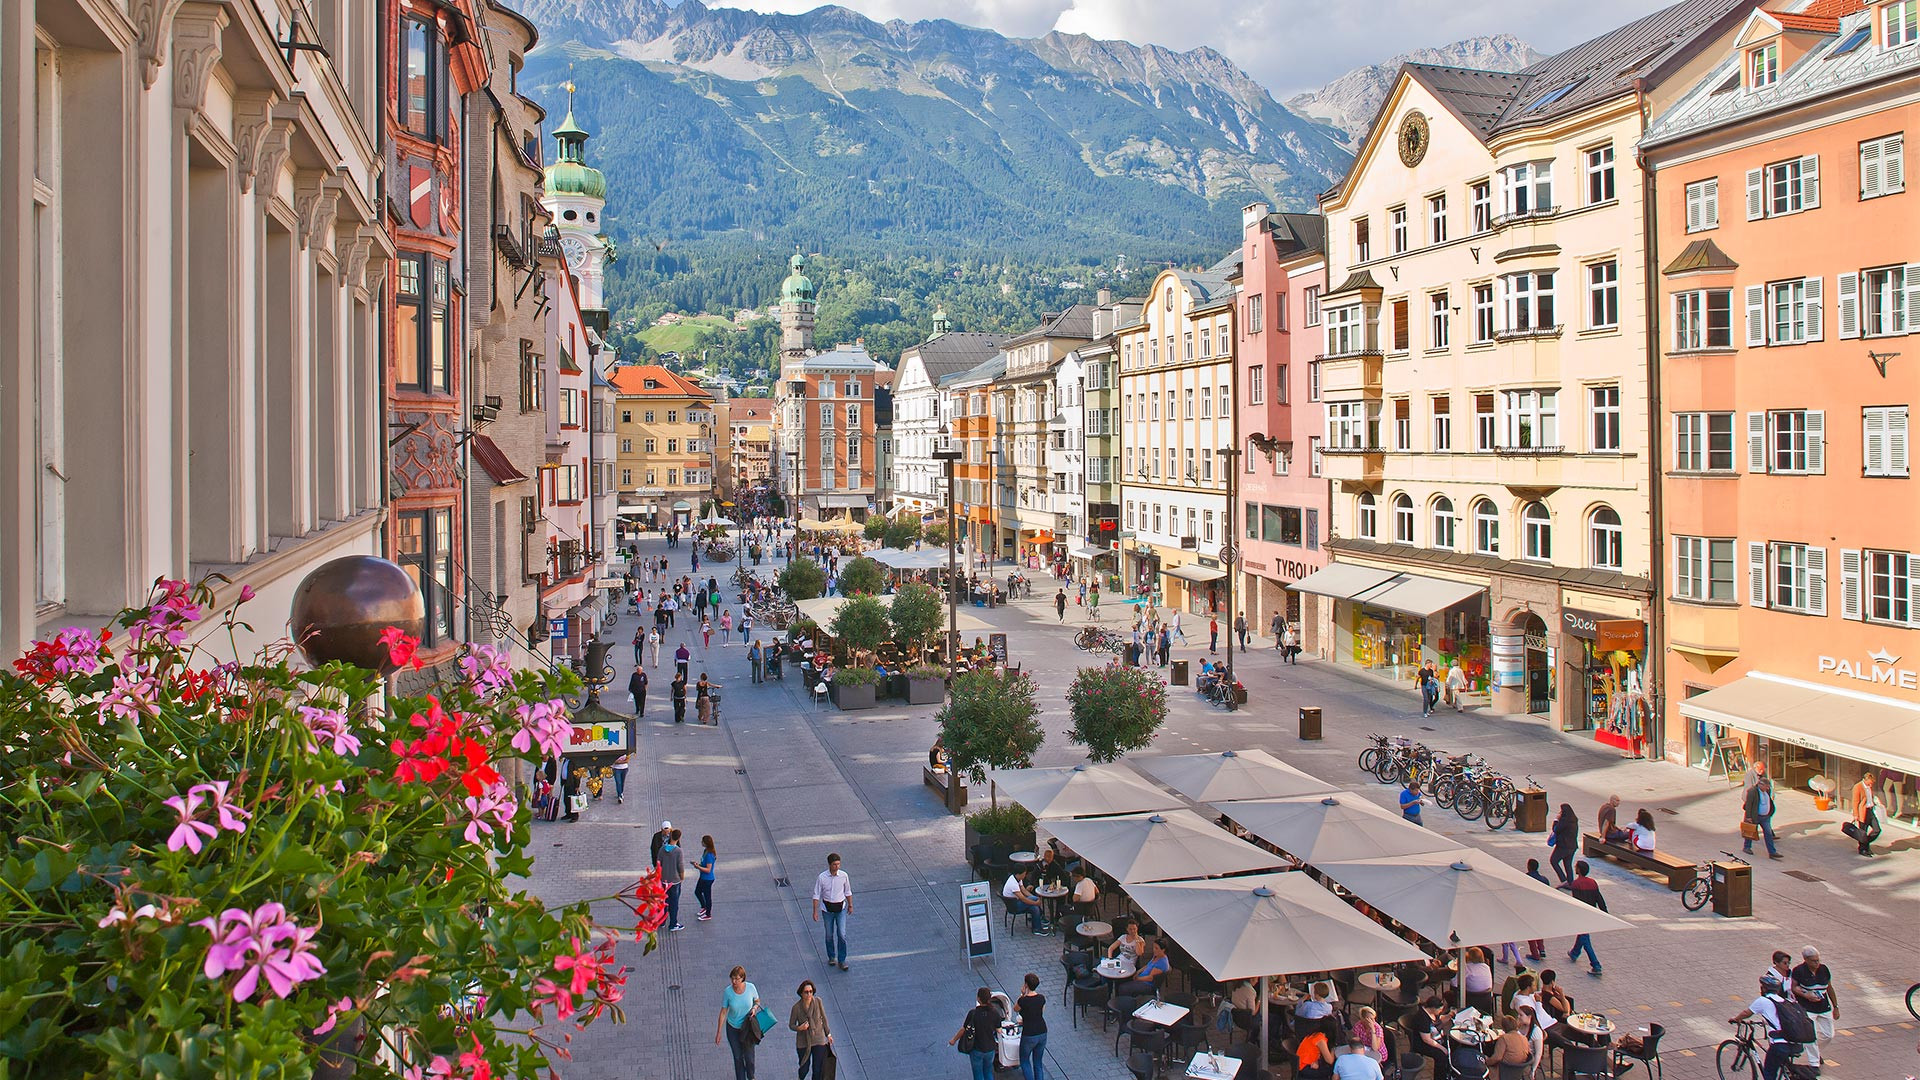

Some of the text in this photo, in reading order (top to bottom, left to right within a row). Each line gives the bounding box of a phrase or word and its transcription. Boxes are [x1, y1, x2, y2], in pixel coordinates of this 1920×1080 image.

[1818, 655, 1918, 691] PALME
[569, 725, 620, 746] ROBIN
[1787, 737, 1819, 750] PALMERS
